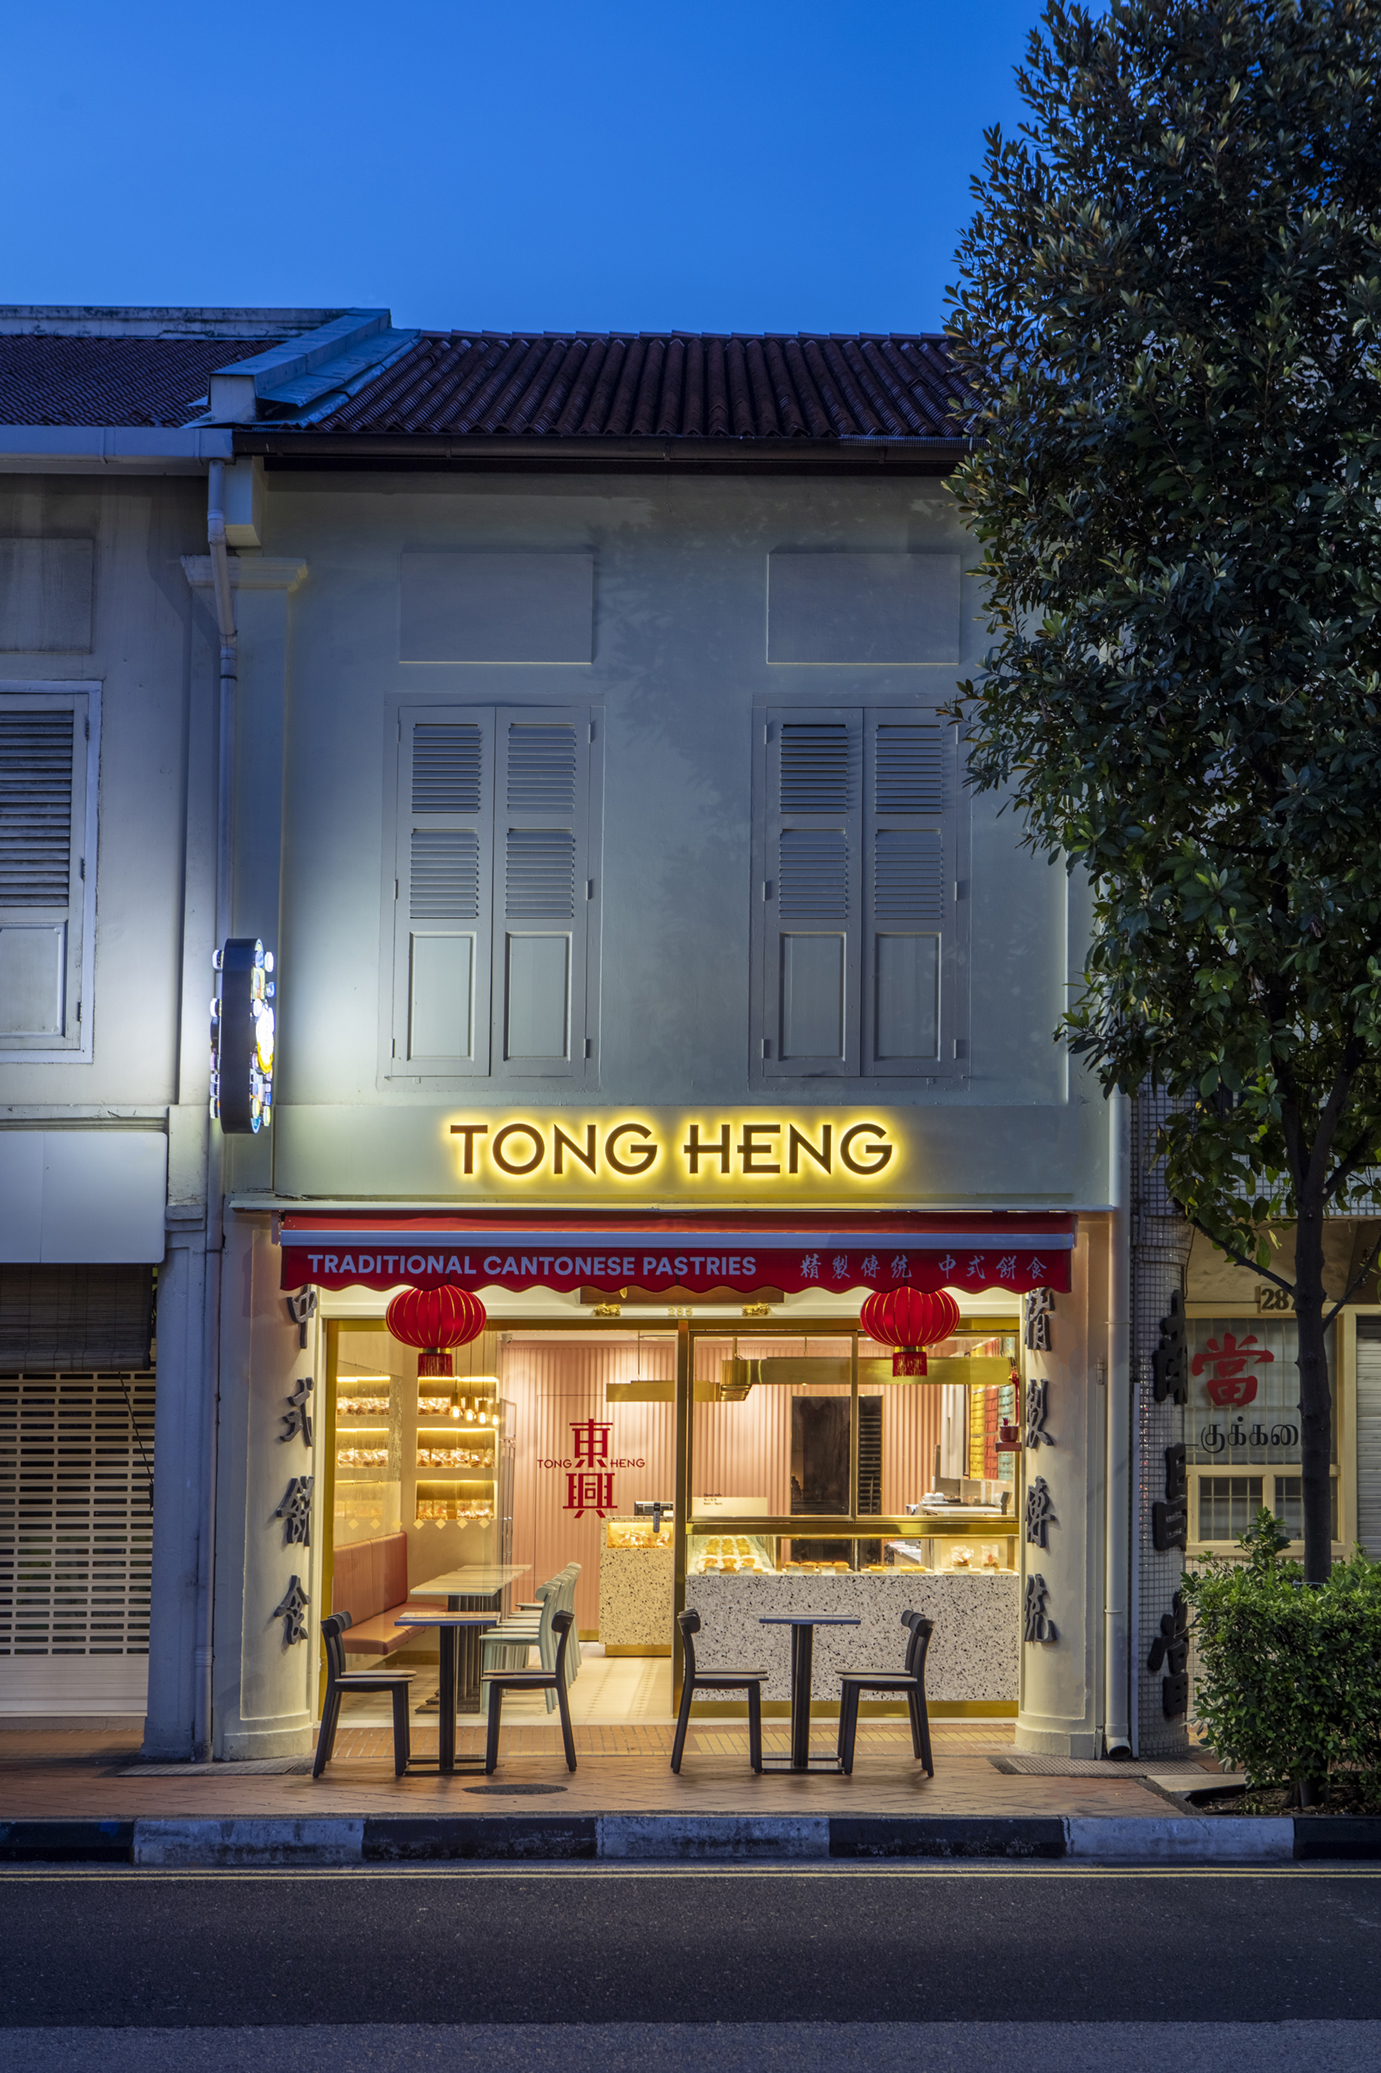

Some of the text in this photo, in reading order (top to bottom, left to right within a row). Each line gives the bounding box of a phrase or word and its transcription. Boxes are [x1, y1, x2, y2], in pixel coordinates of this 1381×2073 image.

[450, 1122, 893, 1175] TONG HENG
[307, 1254, 757, 1276] TRADITIONAL CANTONESE PASTRIES
[800, 1253, 1047, 1280] 精製傳統 中式餅食
[1261, 1288, 1297, 1311] 28
[668, 1306, 693, 1317] 285
[1191, 1332, 1274, 1407] 當
[537, 1458, 645, 1469] TONG HENG
